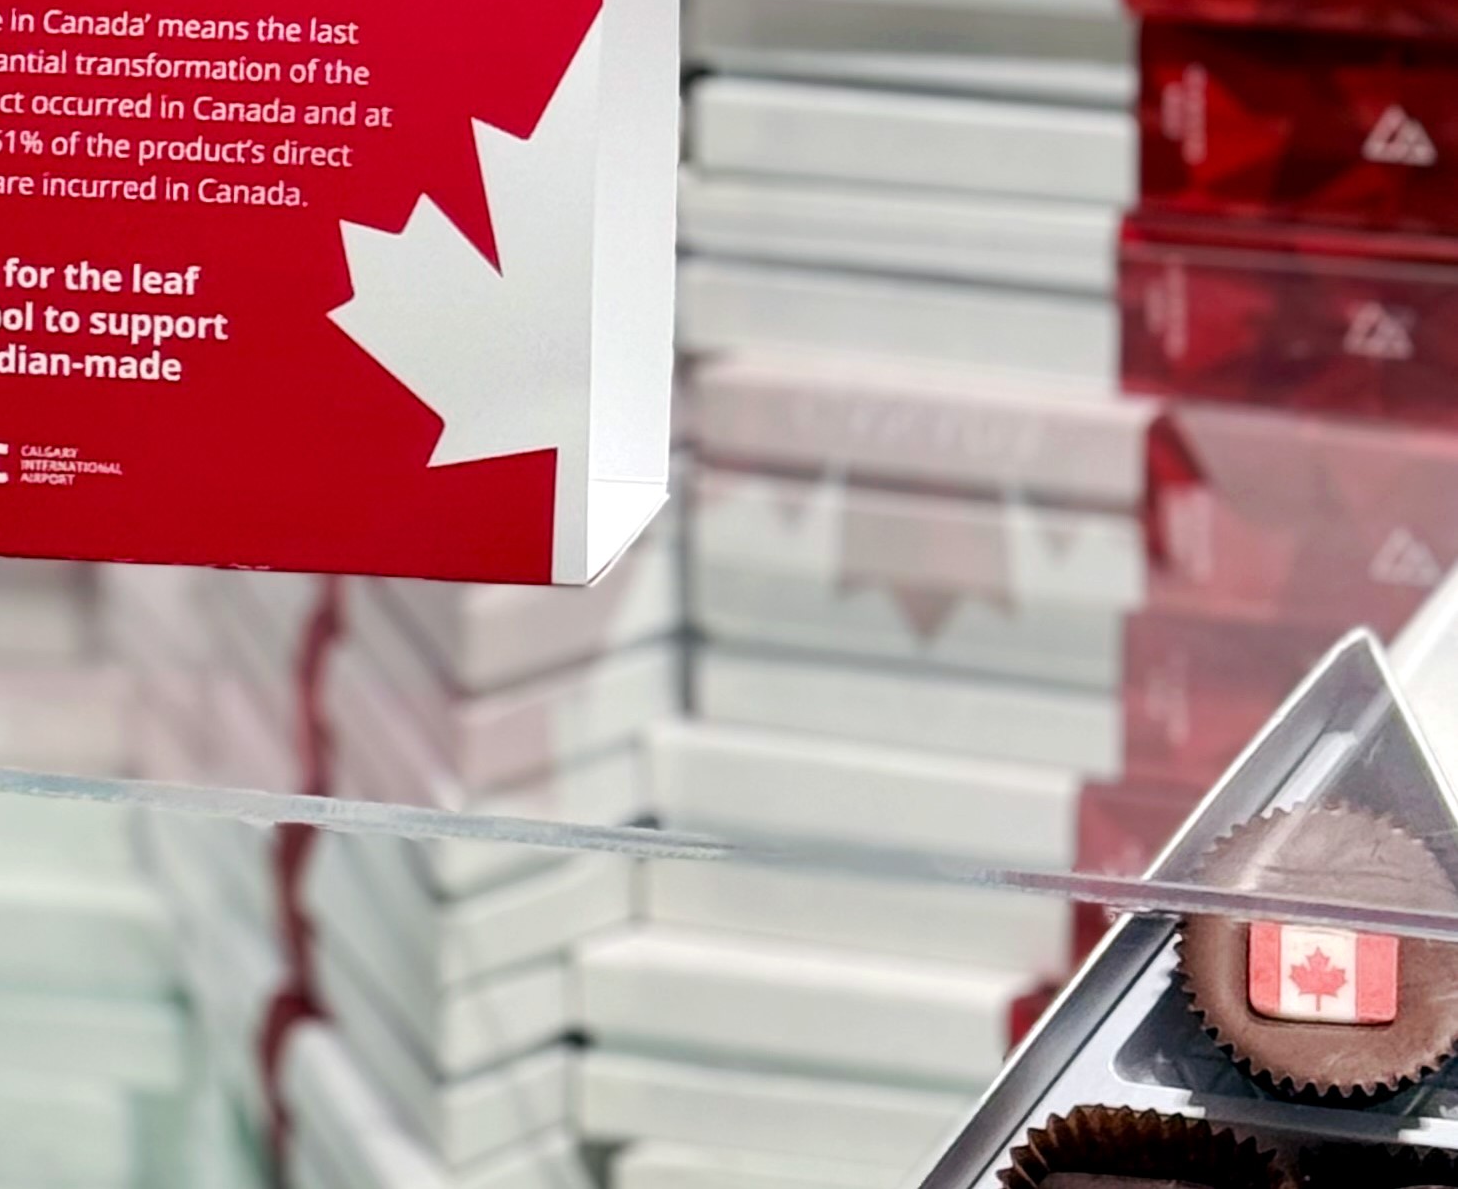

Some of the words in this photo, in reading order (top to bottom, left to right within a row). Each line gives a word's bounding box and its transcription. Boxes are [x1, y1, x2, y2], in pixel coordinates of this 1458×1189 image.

[11, 8, 35, 32] in
[158, 18, 249, 41] means
[257, 16, 302, 43] the
[309, 17, 359, 45] last
[75, 52, 281, 82] transformation
[289, 58, 320, 83] of
[324, 59, 370, 85] the
[31, 93, 152, 118] occurred
[160, 95, 185, 119] in
[193, 96, 296, 124] Canada
[304, 101, 356, 126] and
[364, 106, 392, 127] at
[51, 130, 81, 156] of
[86, 132, 130, 159] the
[273, 139, 352, 167] direct
[43, 175, 157, 200] incurred
[165, 177, 189, 201] in
[197, 178, 307, 207] Canada.
[3, 257, 55, 289] for
[63, 260, 123, 293] the
[132, 263, 201, 296] leaf
[44, 305, 80, 334] to
[89, 312, 229, 346] support
[20, 444, 79, 459] CALGARY
[20, 459, 123, 476] INTERNATIONAL
[20, 473, 76, 486] AIRPORT
